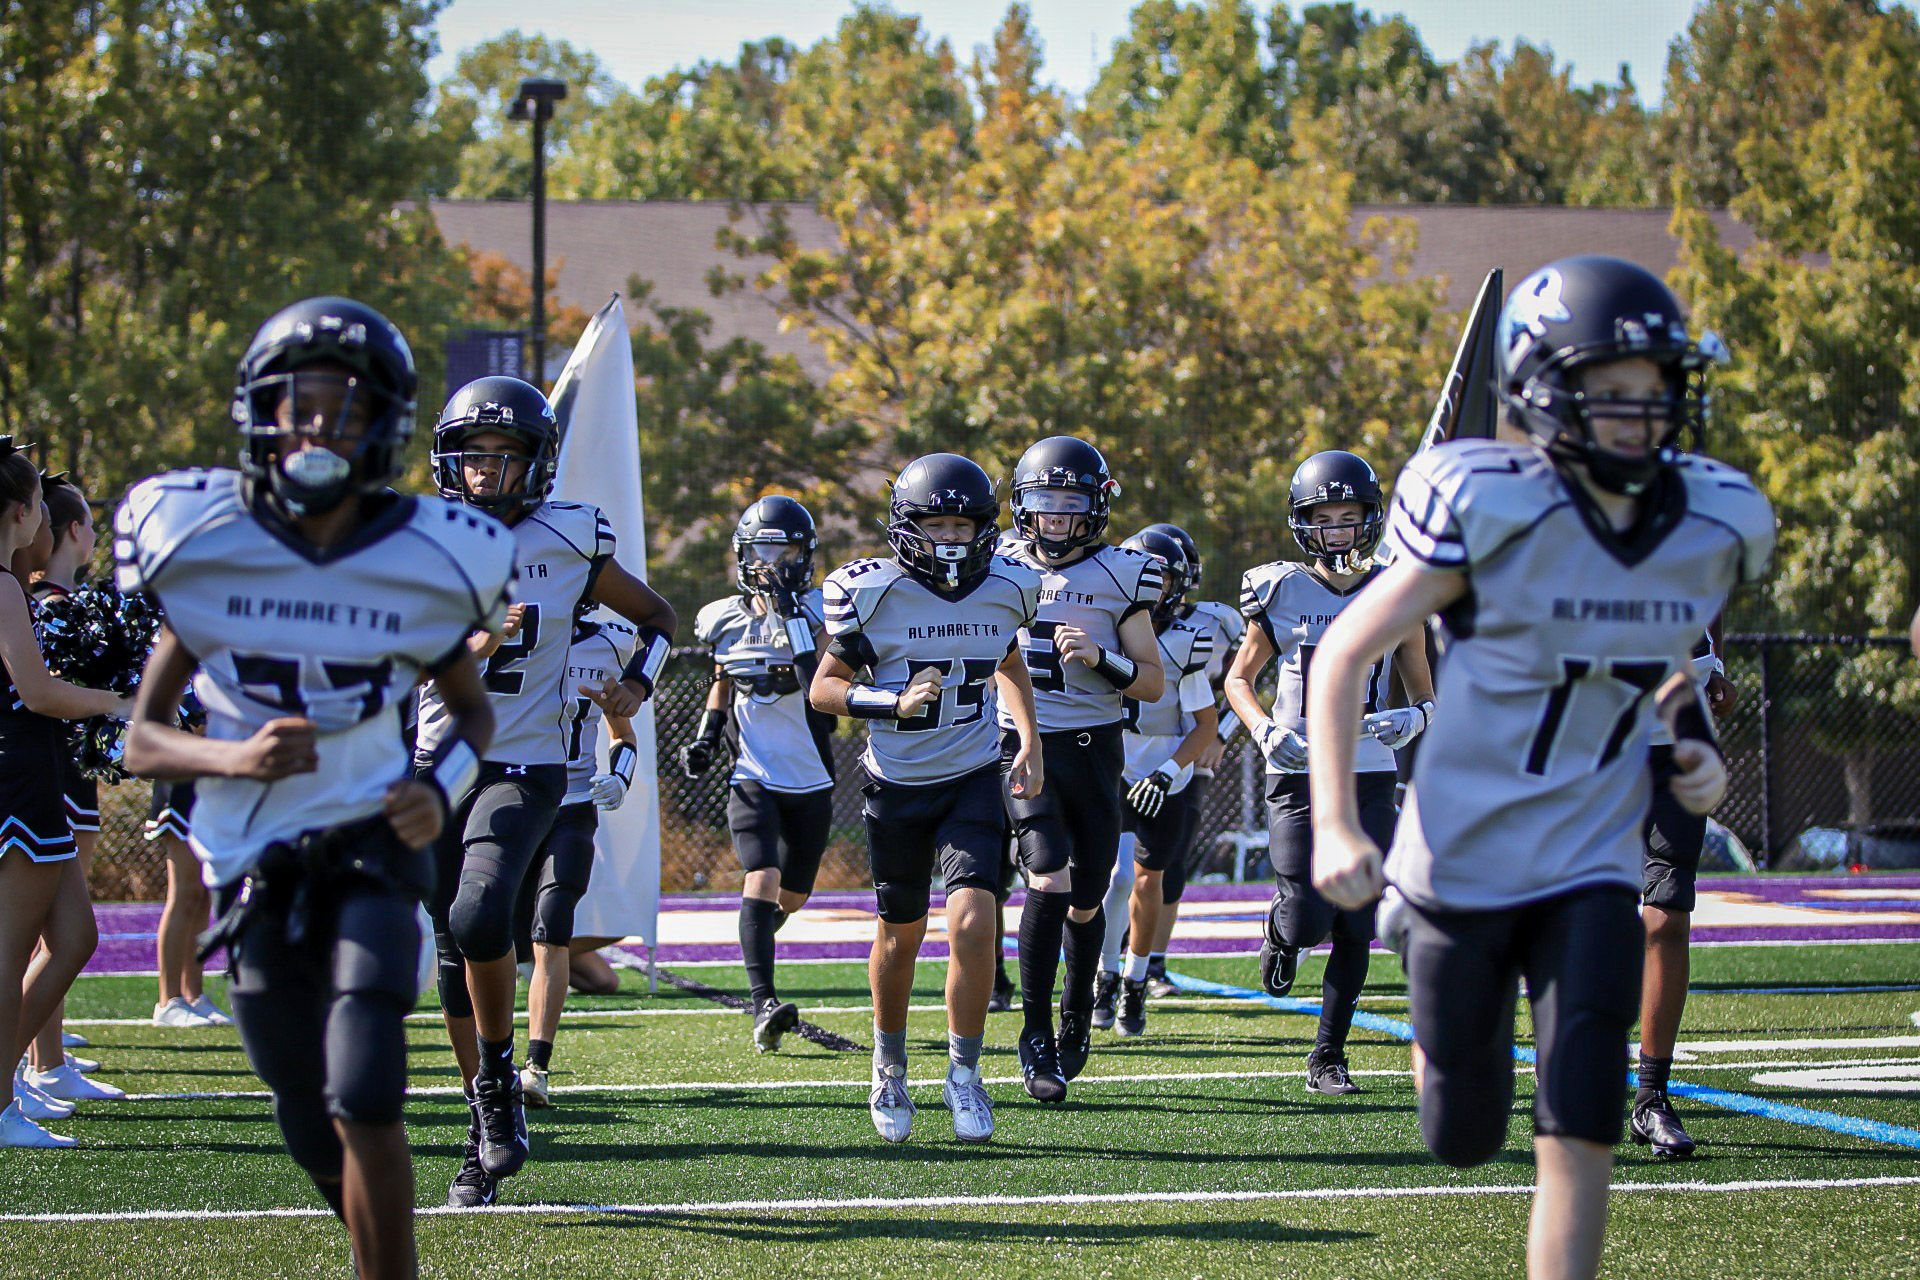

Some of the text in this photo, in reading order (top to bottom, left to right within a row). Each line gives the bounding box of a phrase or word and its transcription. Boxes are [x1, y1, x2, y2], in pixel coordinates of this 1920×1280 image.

[1039, 589, 1094, 606] ARETTA
[1552, 597, 1696, 622] ALPHARETTA
[226, 594, 402, 634] ALPHARETTA
[1299, 614, 1337, 626] ALPH
[908, 623, 1000, 640] ALPHARETTA
[481, 602, 541, 696] 2
[568, 666, 604, 681] ETTA
[895, 657, 1001, 733] 55
[567, 697, 593, 762] 1
[1523, 654, 1674, 779] 17
